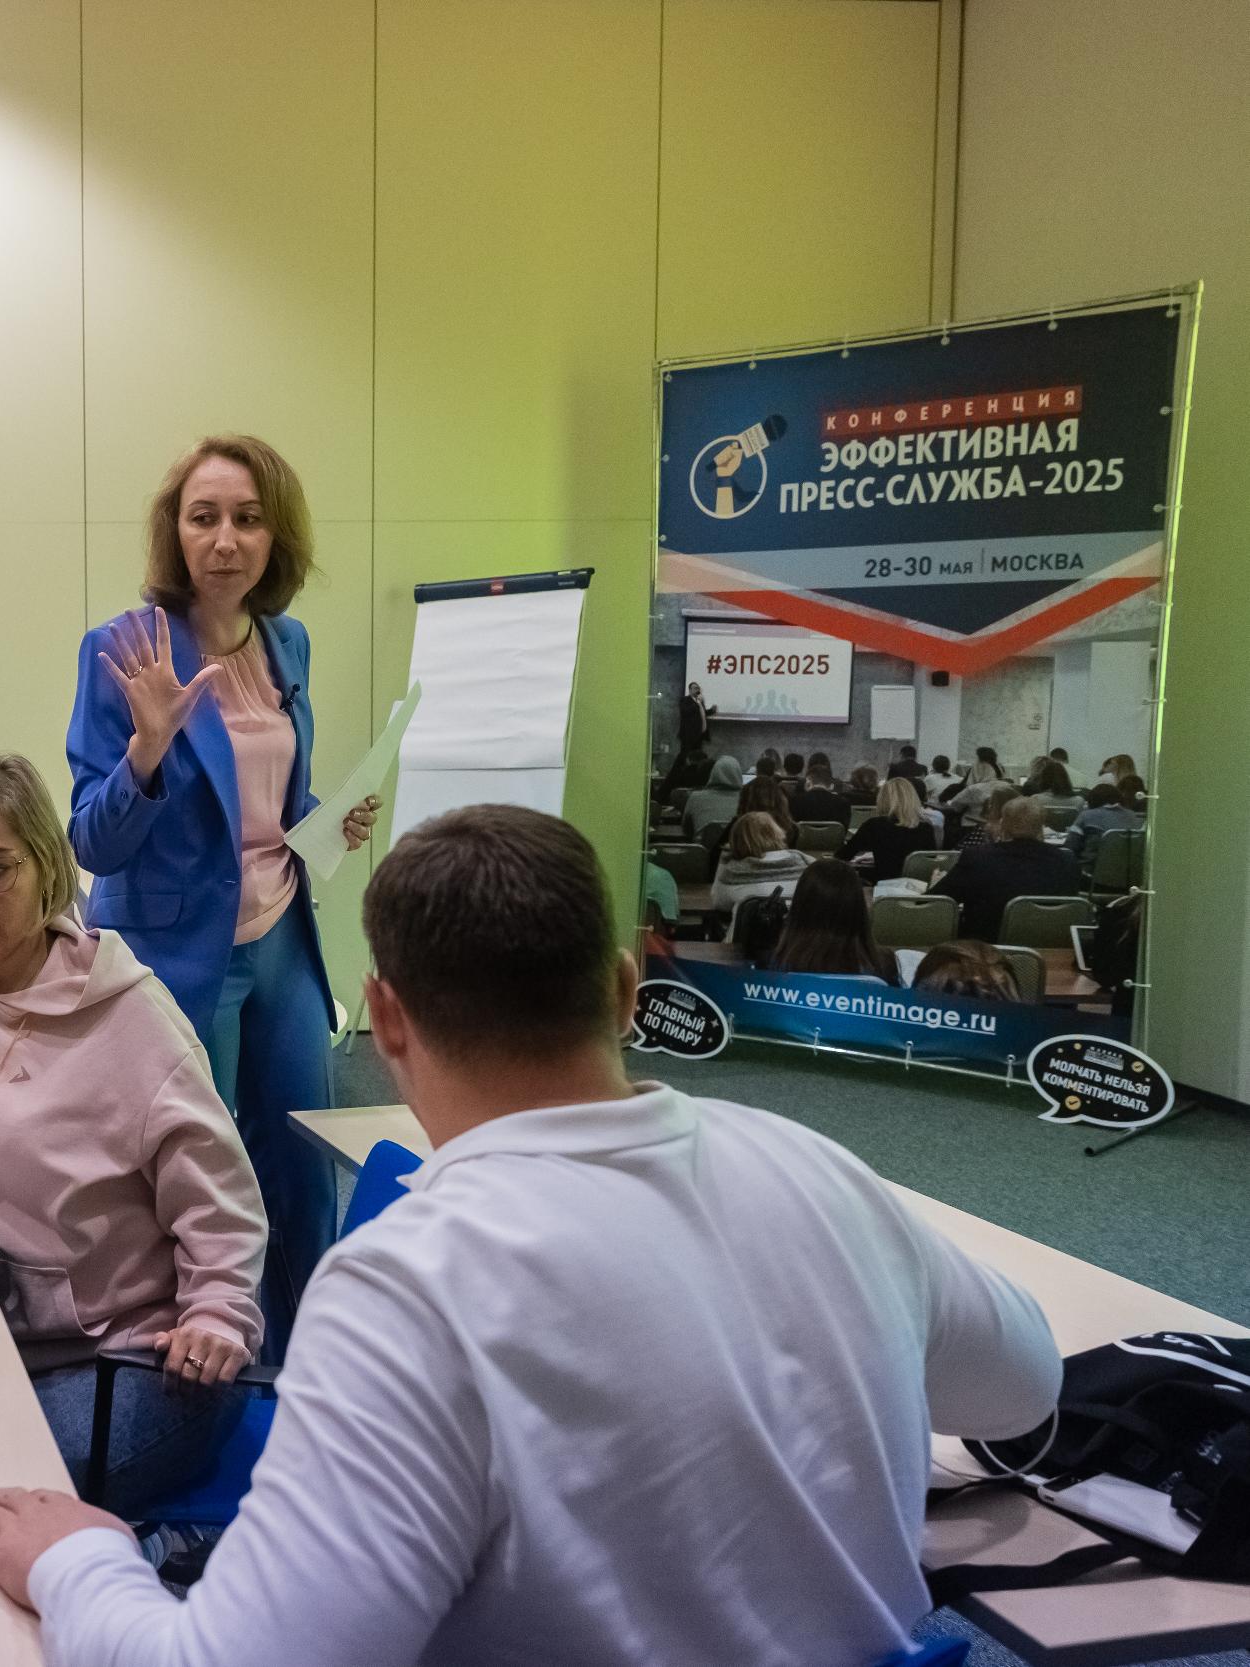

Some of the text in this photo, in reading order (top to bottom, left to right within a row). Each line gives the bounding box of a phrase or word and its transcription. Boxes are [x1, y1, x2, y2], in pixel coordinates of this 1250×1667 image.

[826, 390, 1076, 430] КОНФЕРЕНЦИЯ
[820, 418, 1079, 473] ЭФФЕКТИВНАЯ
[779, 457, 1125, 514] ПРЕСС-СЛУЖБА-2025
[864, 556, 932, 578] 28-30
[991, 553, 1084, 573] МОСКВА
[707, 654, 830, 675] #ЭПС2025
[648, 998, 706, 1033] ГЛАВНЫЙ
[743, 982, 997, 1033] www.eventimage.ru
[643, 1012, 702, 1047] ПО ПИАРУ
[1042, 1071, 1149, 1113] КОММЕНТИРОВАТЬ
[1049, 1058, 1102, 1082] МОЛЧАТЬ
[1104, 1073, 1150, 1097] НЕЛЬЗЯ
